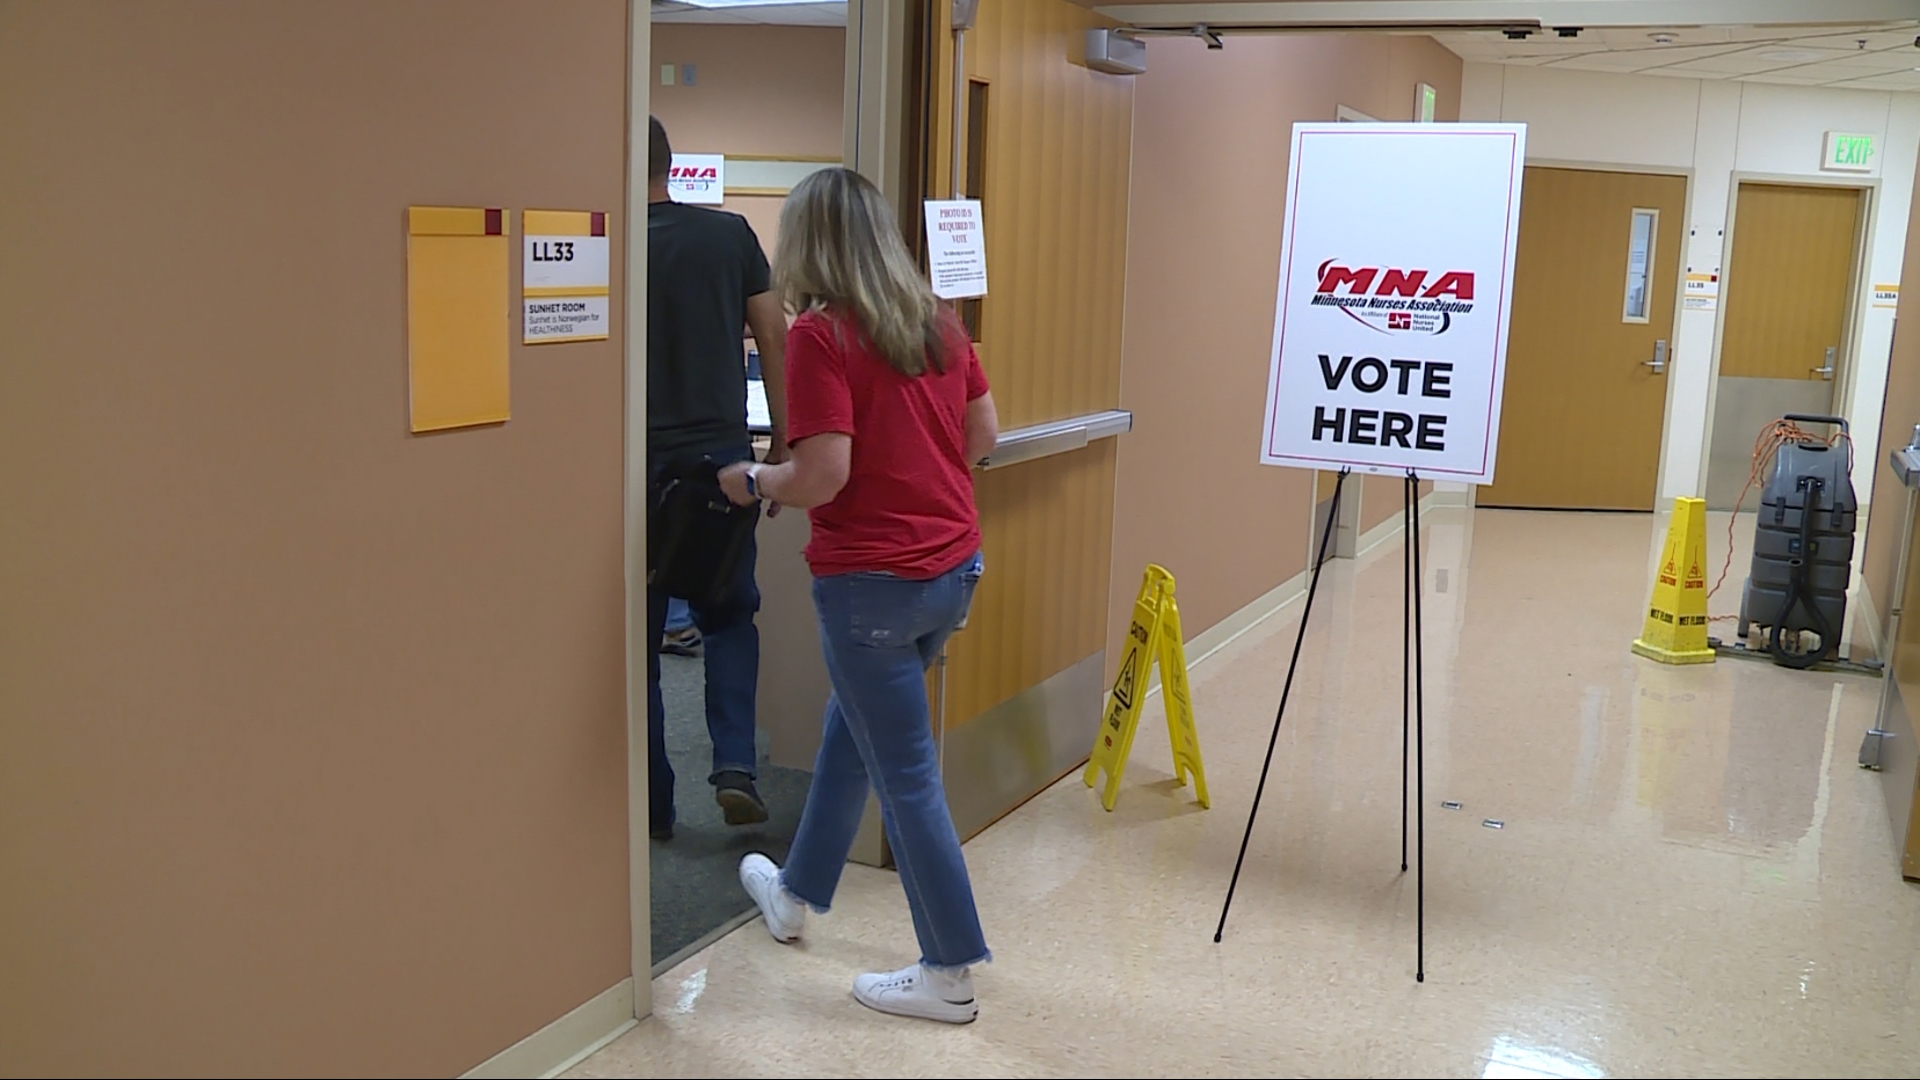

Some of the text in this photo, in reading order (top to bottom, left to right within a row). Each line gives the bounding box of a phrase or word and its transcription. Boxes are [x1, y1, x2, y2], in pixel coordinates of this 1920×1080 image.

[1835, 135, 1872, 165] EXIT
[940, 209, 960, 218] PHOTO
[938, 222, 975, 232] REQUIRED TO
[952, 235, 967, 243] VOTE
[533, 242, 574, 262] LL33
[1317, 266, 1474, 300] MNA
[529, 303, 585, 314] SUNHET ROOM
[1311, 294, 1473, 313] Minnesota Nurses Association
[529, 316, 551, 325] Sunhet
[558, 315, 590, 324] Norwegian
[591, 313, 600, 321] for
[529, 324, 573, 335] HEALTHINESS
[1317, 354, 1454, 399] VOTE
[1311, 405, 1448, 452] HERE
